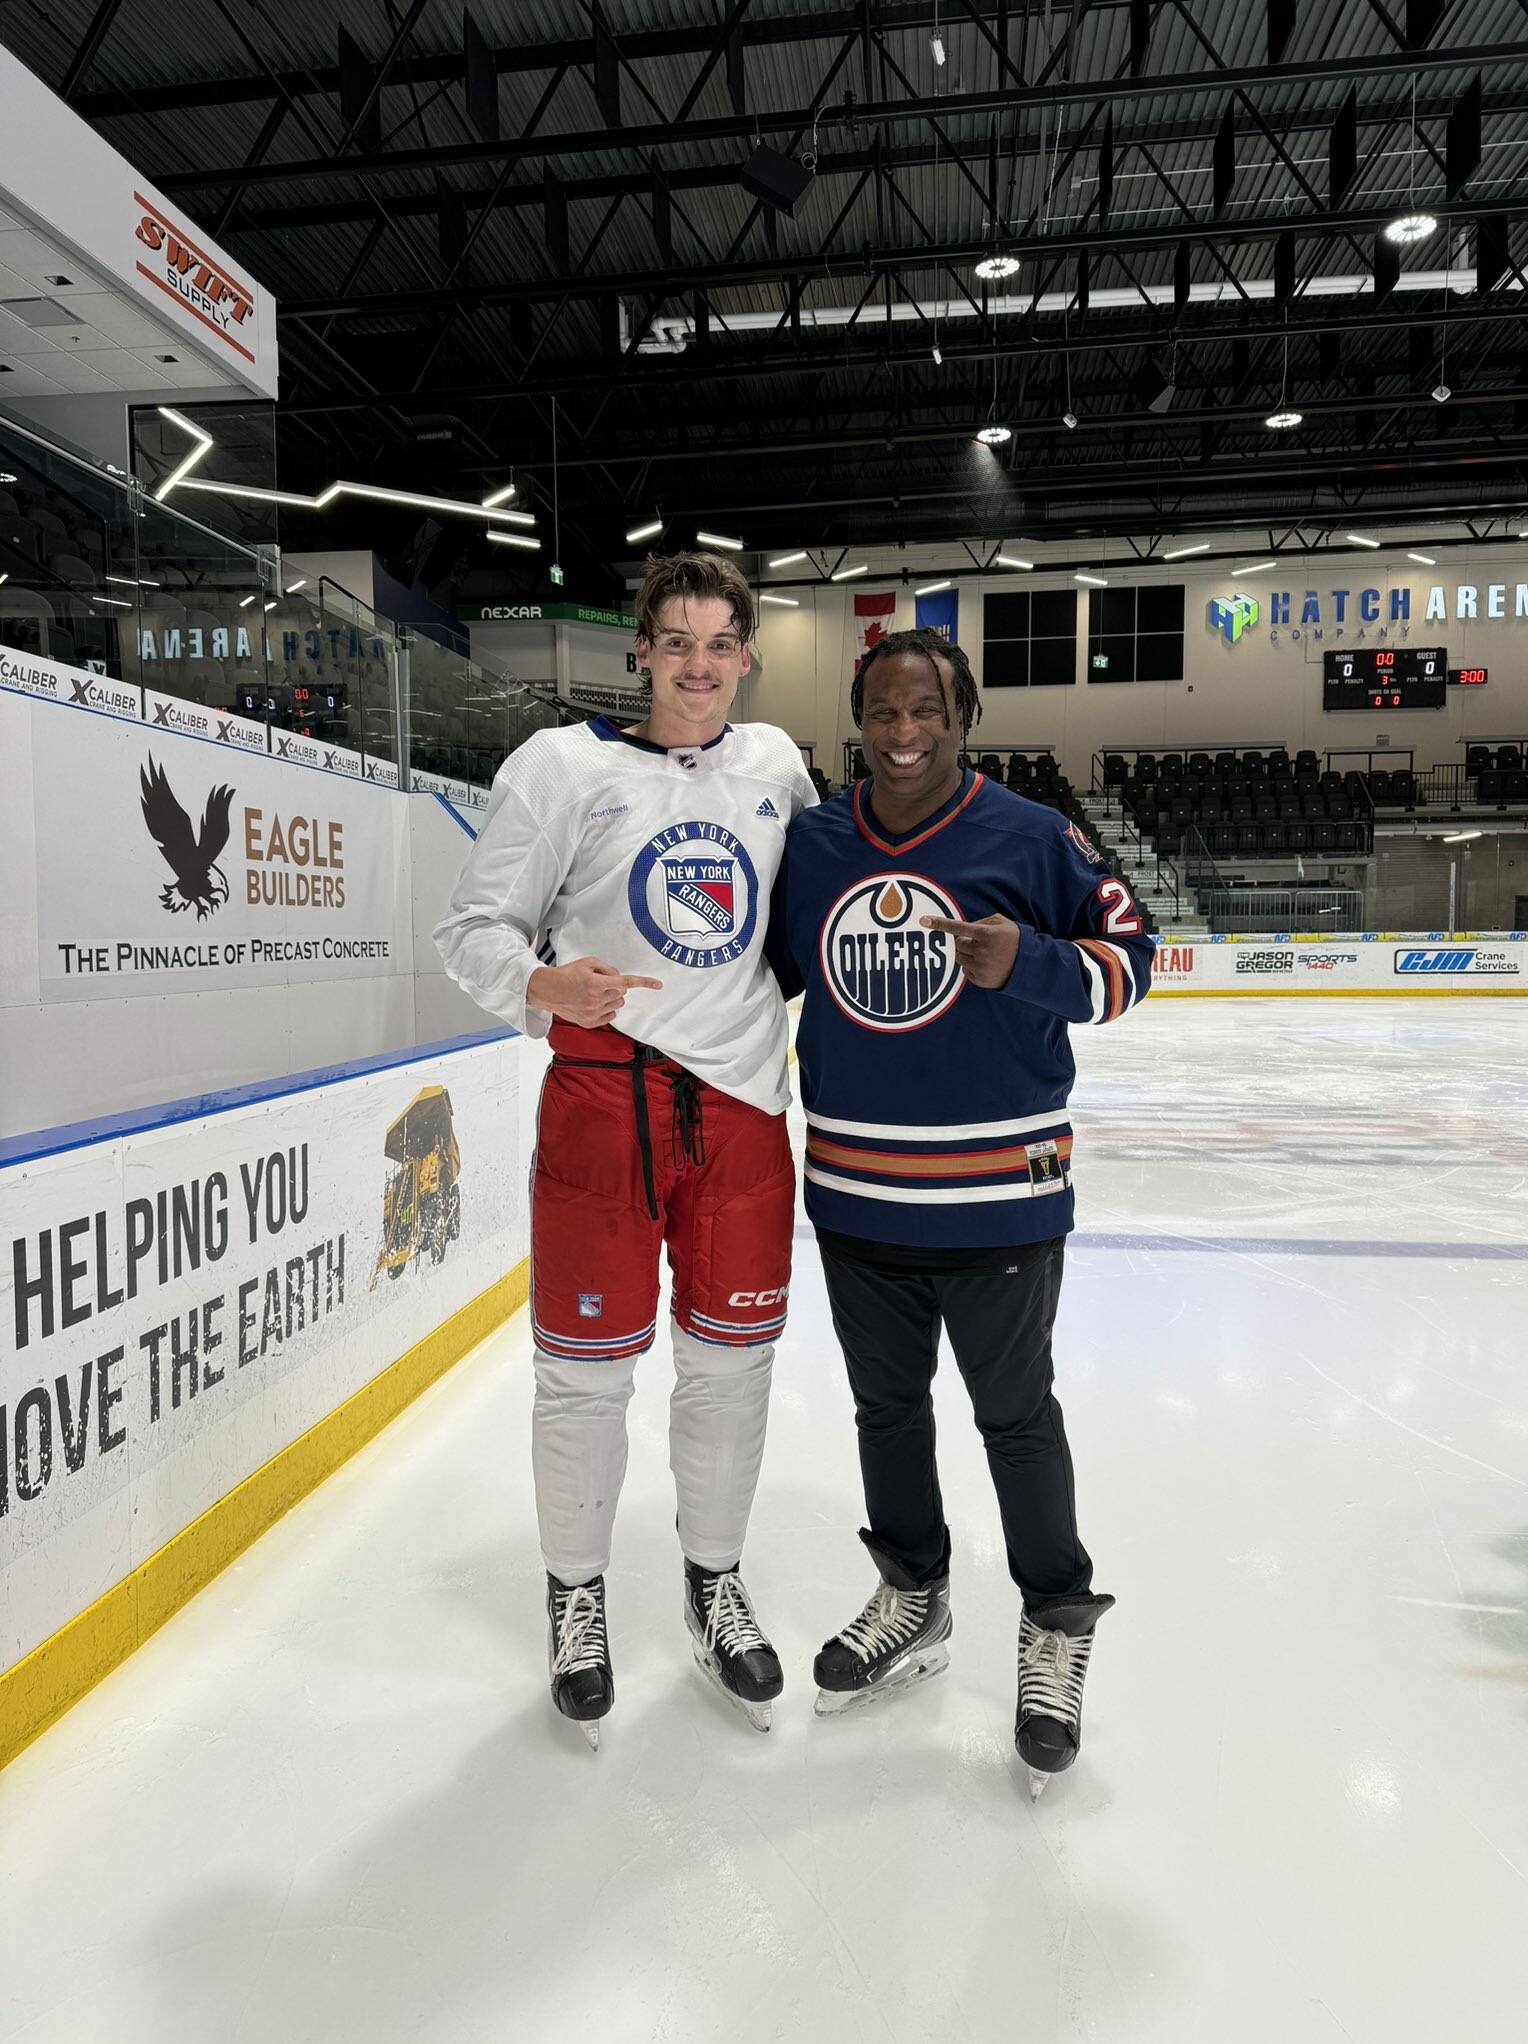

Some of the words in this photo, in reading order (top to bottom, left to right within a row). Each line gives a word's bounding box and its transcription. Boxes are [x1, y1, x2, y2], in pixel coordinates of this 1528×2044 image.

[135, 216, 254, 325] SWIFT
[167, 268, 229, 328] SUPPLY
[481, 606, 542, 619] NEXAR
[578, 608, 621, 626] REPAIRS,
[1271, 588, 1411, 624] HATCH
[1270, 627, 1411, 642] COMPANY
[1416, 652, 1437, 660] GUEST
[0, 654, 58, 691] CALIBER
[1343, 664, 1352, 676] 0
[1425, 661, 1434, 674] 0
[1460, 670, 1485, 683] 3:00
[1381, 675, 1388, 685] 3
[68, 678, 136, 711] XCALIBER
[152, 702, 208, 730] XCALIBER
[216, 720, 264, 746] XCALIBER
[277, 737, 318, 760] XCALIBER
[323, 750, 359, 771] XCALIBER
[366, 762, 398, 781] XCALIBER
[590, 804, 629, 820] Northwell
[756, 808, 780, 820] adidas
[244, 807, 344, 869] EAGLE
[651, 823, 688, 853] NEW
[698, 822, 740, 852] YORK
[667, 865, 696, 880] NEW
[700, 865, 731, 880] YORK
[246, 870, 345, 908] BUILDERS
[678, 883, 732, 930] RANGERS
[1100, 879, 1139, 934] 2
[58, 943, 109, 974] THE
[117, 942, 219, 970] PINNACLE
[224, 943, 246, 964] OF
[251, 938, 319, 963] PRECAST
[323, 937, 390, 960] CONCRETE
[661, 938, 743, 967] RANGERS
[1249, 951, 1294, 961] JASON
[1297, 954, 1358, 966] SPORTS
[1475, 952, 1506, 961] Crane
[839, 930, 947, 1006] OILERS
[1236, 960, 1294, 971] GREGOR
[1475, 961, 1518, 971] Services
[12, 1170, 229, 1351] HELPING
[240, 1142, 309, 1243] YOU
[139, 1294, 225, 1424] THE
[238, 1233, 346, 1370] EARTH
